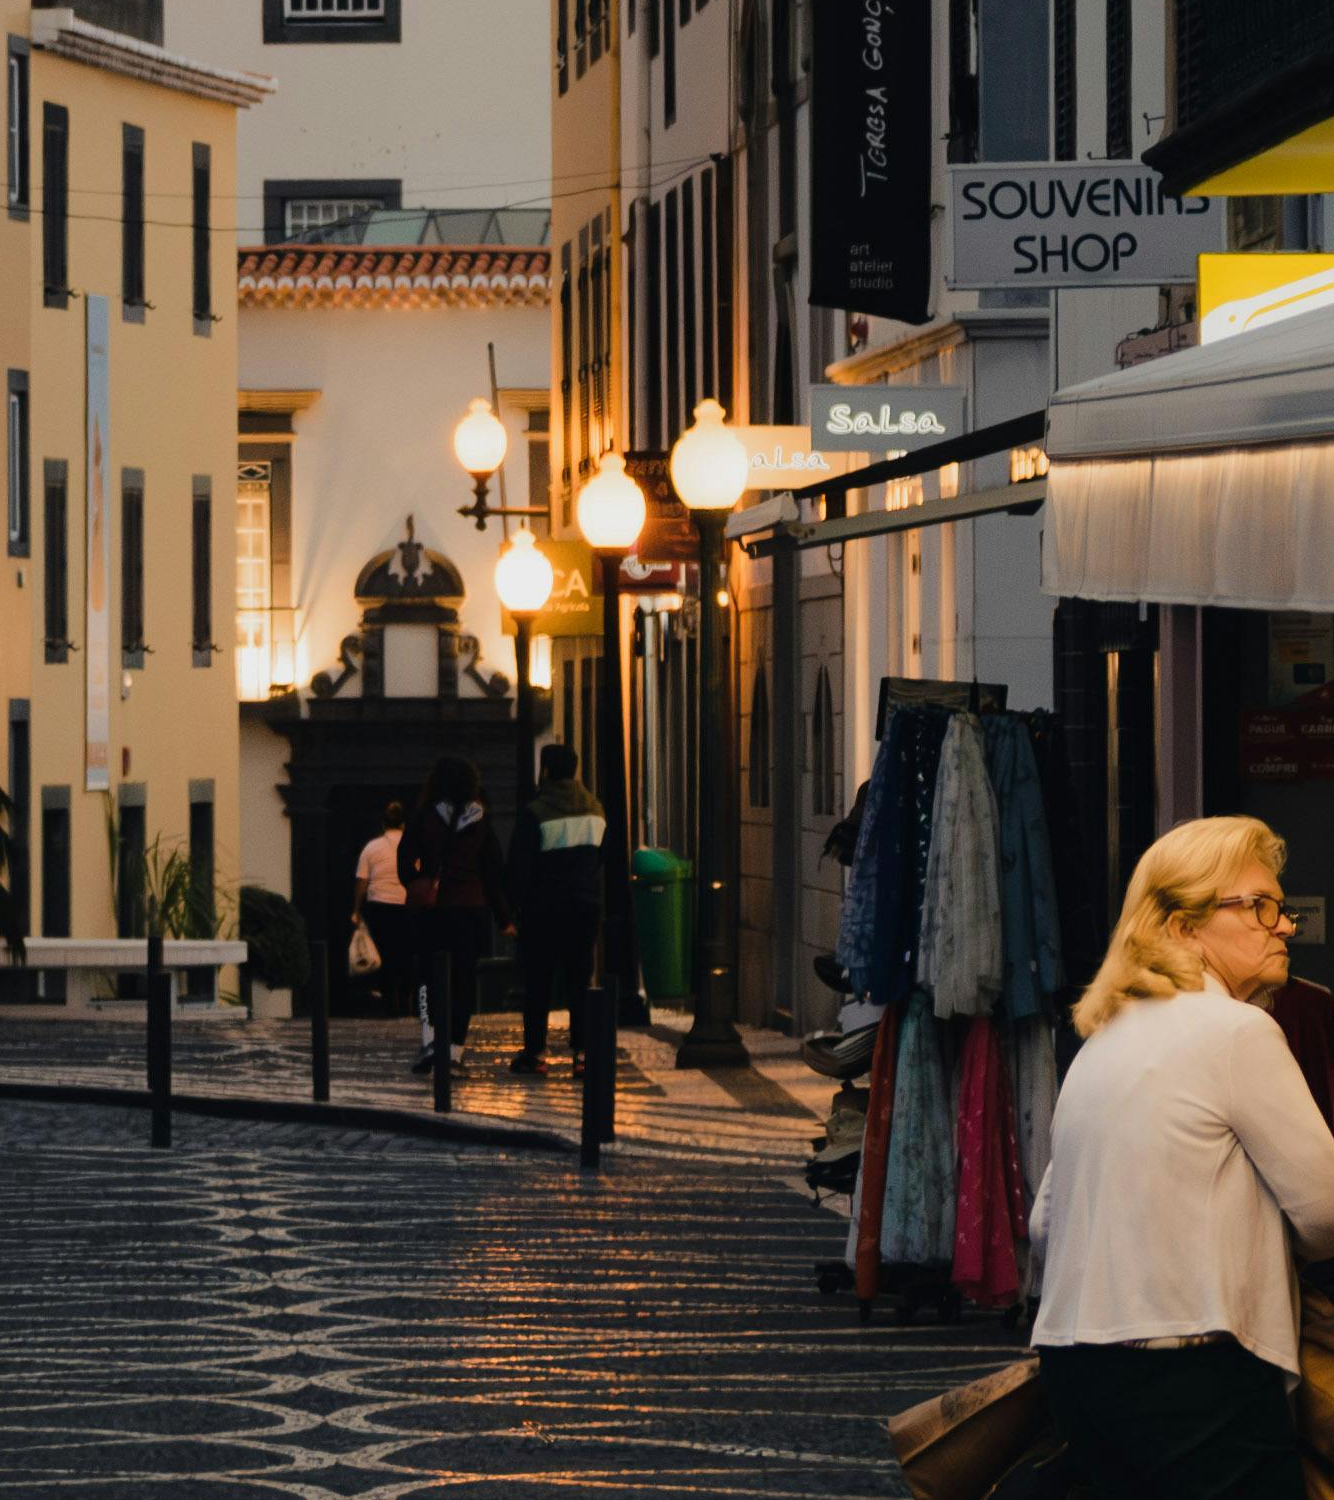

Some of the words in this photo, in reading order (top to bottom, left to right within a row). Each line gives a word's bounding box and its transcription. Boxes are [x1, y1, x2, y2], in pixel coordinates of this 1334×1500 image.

[850, 242, 870, 256] art
[1013, 232, 1138, 274] SHOP
[850, 258, 893, 272] atelier
[850, 275, 894, 290] studio
[746, 446, 830, 472] alsa
